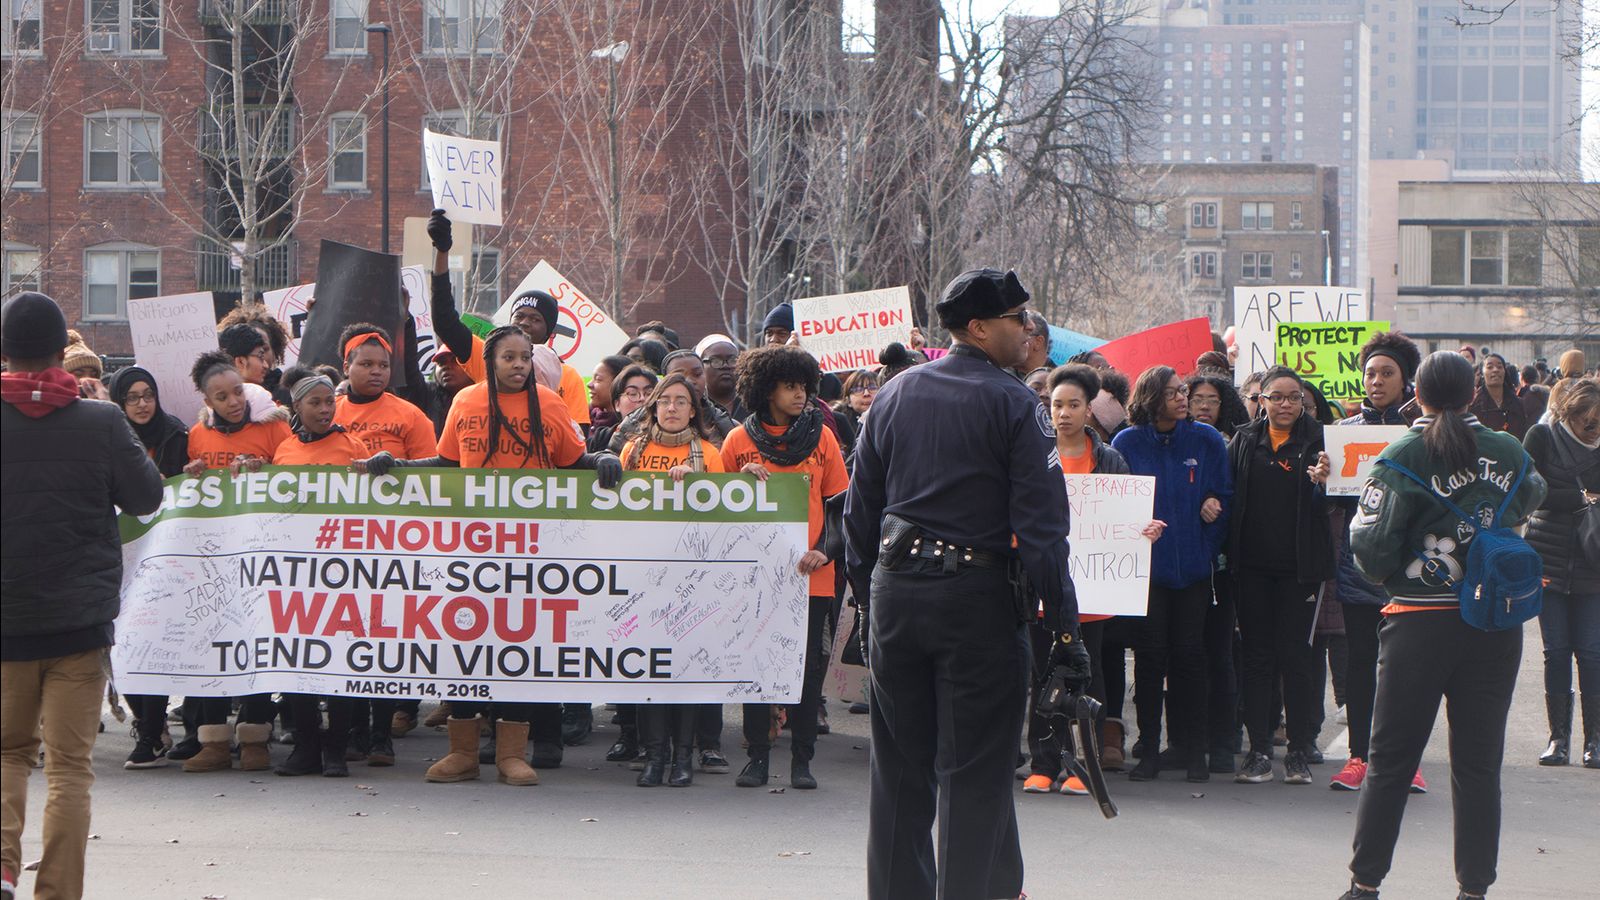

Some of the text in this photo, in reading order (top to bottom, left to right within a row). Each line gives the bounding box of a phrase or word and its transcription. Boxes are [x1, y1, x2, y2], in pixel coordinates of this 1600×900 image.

[432, 178, 496, 212] AIN
[129, 301, 199, 321] Politicians
[548, 282, 605, 328] STOP
[847, 289, 900, 311] WANT
[801, 309, 904, 337] EDUCATION
[1278, 325, 1366, 347] PROTECT
[1145, 327, 1192, 358] had
[1282, 350, 1317, 374] US
[1095, 477, 1153, 498] PRAYERS
[1431, 456, 1514, 498] Cass Tech
[137, 476, 223, 524] ASS
[231, 472, 452, 508] TECHNICAL
[464, 475, 578, 509] HIGH
[591, 477, 778, 512] SCHOOL
[1363, 485, 1385, 510] 18
[315, 518, 540, 555] #ENOUGH!
[1079, 522, 1142, 541] LIVES
[240, 555, 432, 592] NATIONAL
[445, 560, 629, 596] SCHOOL
[1069, 551, 1148, 581] NTROL
[184, 574, 231, 610] JADEN
[268, 590, 579, 643] WALKOUT
[212, 639, 249, 672] TO
[255, 637, 332, 670] END
[346, 640, 438, 675] GUN
[453, 644, 673, 679] VIOLENCE
[345, 680, 412, 696] MARCH
